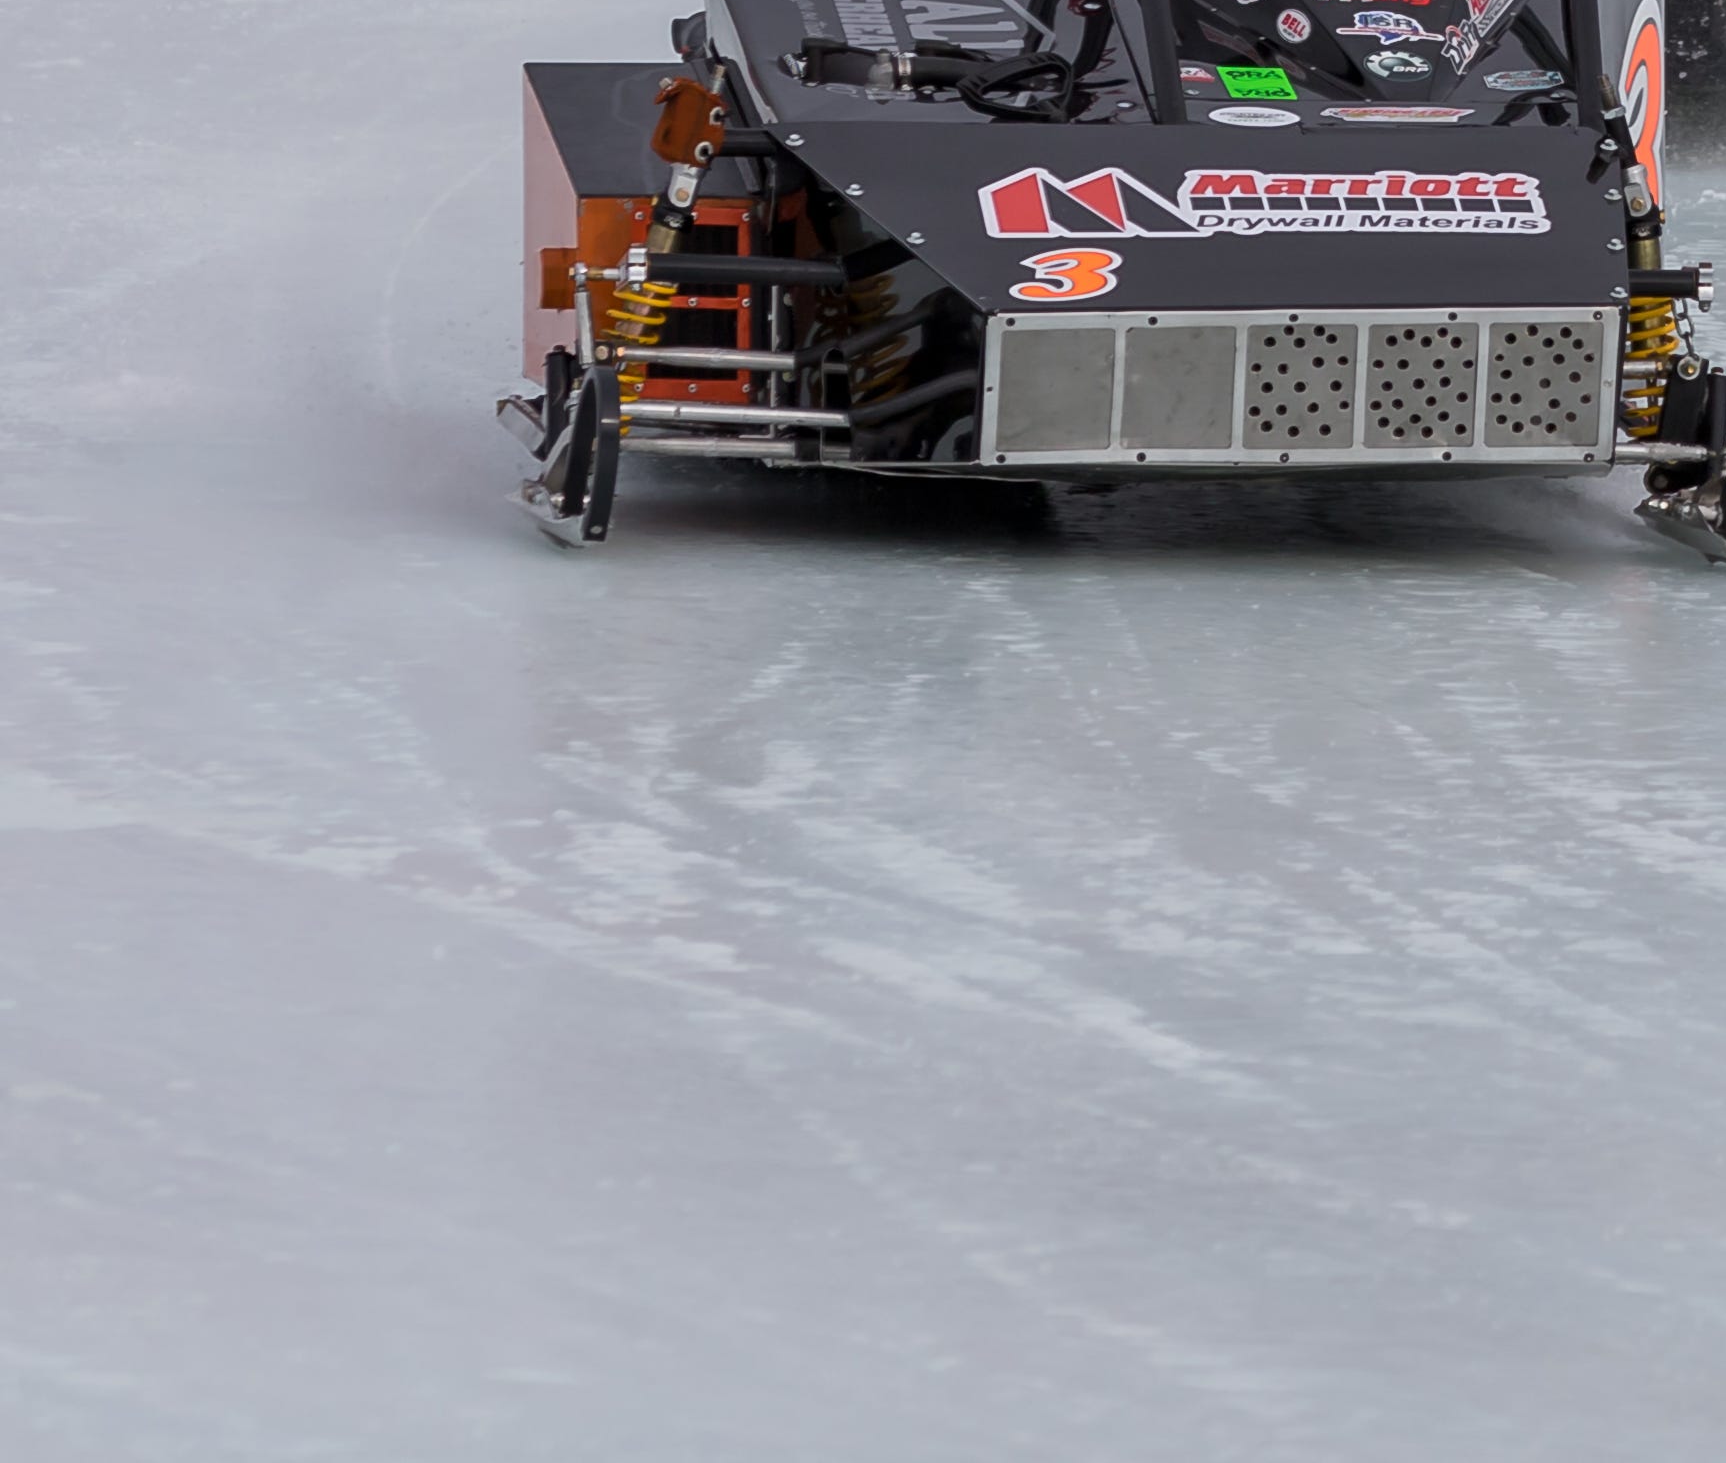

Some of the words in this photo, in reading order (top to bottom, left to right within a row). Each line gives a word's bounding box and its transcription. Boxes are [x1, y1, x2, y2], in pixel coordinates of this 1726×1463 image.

[1281, 13, 1305, 38] BELL
[1392, 65, 1430, 73] BRP
[1189, 174, 1530, 198] Marriott
[1198, 214, 1346, 235] Drywall
[1359, 214, 1540, 232] Materials
[1009, 248, 1123, 301] 3
